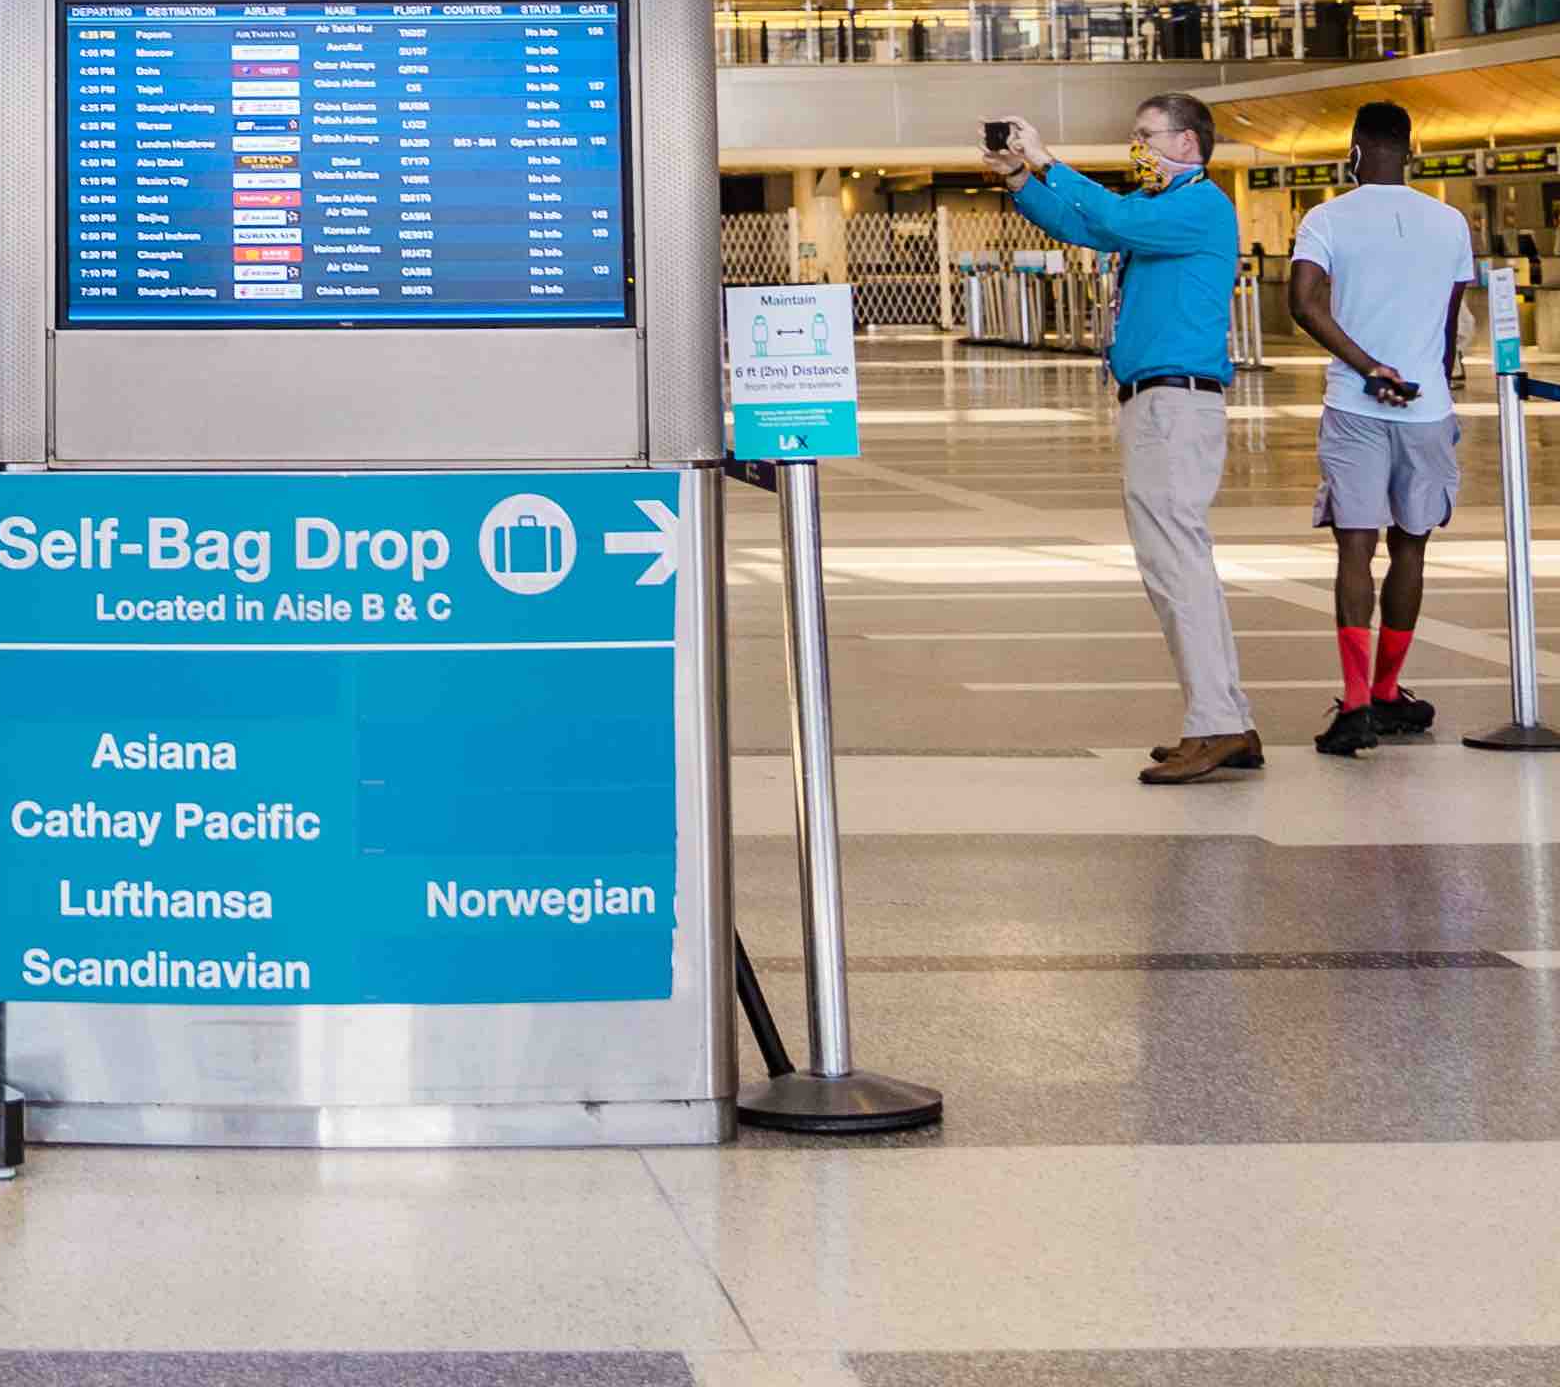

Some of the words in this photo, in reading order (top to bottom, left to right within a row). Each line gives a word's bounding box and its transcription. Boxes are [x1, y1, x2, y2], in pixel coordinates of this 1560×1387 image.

[760, 295, 816, 306] Maintain
[792, 365, 849, 376] Distance
[779, 434, 808, 449] LAX
[295, 515, 450, 581] Drop
[95, 592, 225, 622] Located
[235, 593, 264, 621] in
[272, 593, 352, 620] Aisle
[362, 594, 385, 620] B
[394, 594, 417, 620] &
[425, 594, 452, 620] C
[91, 732, 237, 770] Asiana
[10, 800, 161, 846] Cathay
[175, 802, 320, 840] Pacific
[59, 879, 273, 919] Lufthansa
[426, 879, 656, 924] Norwegian
[22, 948, 310, 990] Scandinavian
